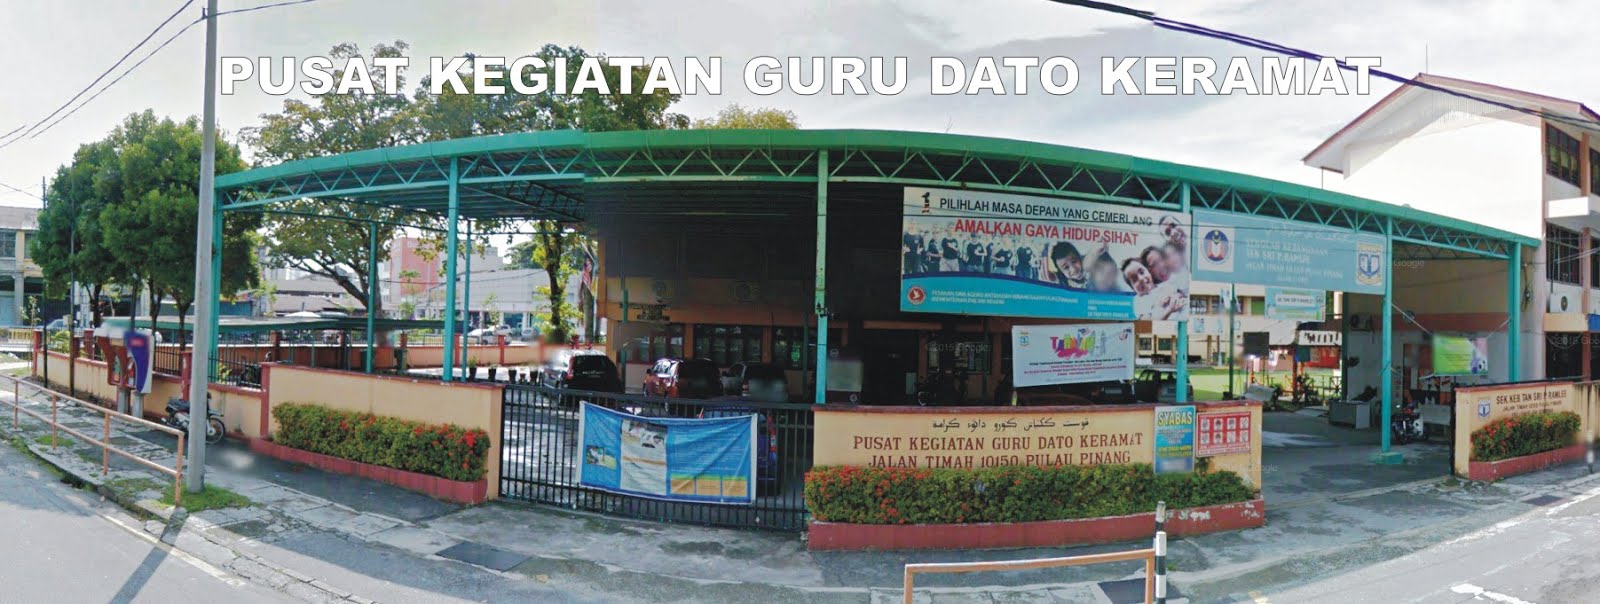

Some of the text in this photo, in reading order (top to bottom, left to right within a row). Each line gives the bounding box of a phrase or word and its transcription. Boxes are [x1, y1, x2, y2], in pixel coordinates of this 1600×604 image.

[940, 198, 990, 213] PILIHLAH
[992, 202, 1023, 215] MASA
[1025, 204, 1060, 218] DEPAN
[1062, 207, 1090, 221] YANG
[955, 218, 1139, 246] AMALKAN GAYA HIDUP SIHAT
[1522, 392, 1533, 402] TAN
[1157, 411, 1193, 426] SYABAS
[853, 436, 901, 450] PUSAT
[909, 437, 985, 450] KEGIATAN
[992, 437, 1031, 450] GURU
[1038, 435, 1074, 449] DATO
[1080, 432, 1143, 448] KERAMAT
[868, 450, 1131, 469] JALAN TIMAH 10150 PULAU PINANG
